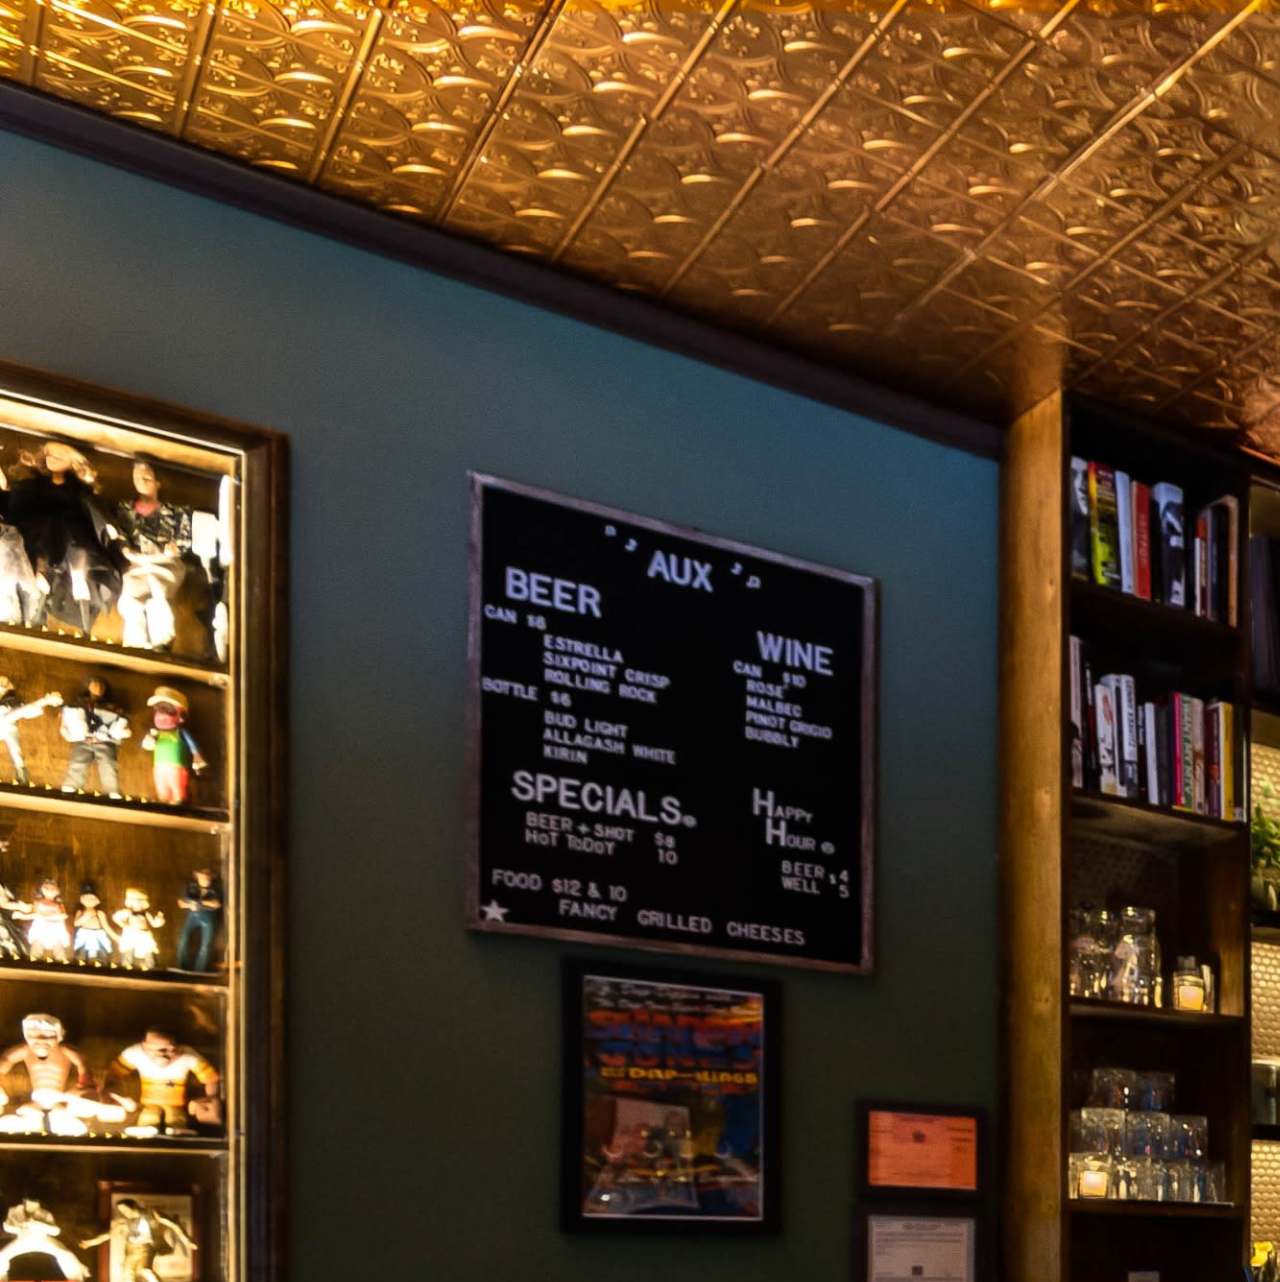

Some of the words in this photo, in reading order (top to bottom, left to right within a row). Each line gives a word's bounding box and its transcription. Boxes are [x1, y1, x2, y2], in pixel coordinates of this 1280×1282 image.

[647, 550, 713, 592] AUX
[505, 566, 602, 618] BEER
[484, 603, 517, 624] CAN
[543, 633, 624, 663] ESTRELLA
[757, 630, 834, 676] WINE
[543, 651, 618, 678] SIXPOINT
[624, 668, 671, 689] CRISP
[733, 659, 762, 678] CAN
[482, 676, 538, 700] BOTTLE
[544, 668, 611, 694] ROLLING
[618, 683, 657, 703] ROCK
[746, 694, 802, 718] MALBEC
[544, 710, 577, 729] BUD
[584, 718, 628, 739] LIGHT
[745, 726, 799, 748] BUBBLY
[746, 710, 786, 730] PINOT
[789, 720, 833, 739] GRIGIO
[543, 727, 625, 754] ALLAGASH
[632, 744, 676, 765] WHITE
[543, 745, 588, 764] KIRIN
[511, 770, 682, 825] SPECIALS
[526, 811, 573, 832] BEER
[594, 824, 635, 842] SHOT
[658, 849, 679, 865] 10
[782, 860, 825, 879] BEER
[839, 869, 849, 882] 4
[491, 868, 542, 891] FOOD
[552, 878, 582, 897] $12
[588, 882, 601, 899] &
[609, 885, 628, 901] 10
[782, 876, 820, 895] WELL
[839, 884, 849, 898] 5
[559, 900, 617, 921] FANCY
[637, 909, 713, 934] GRILLED
[727, 921, 806, 945] CHEESES
